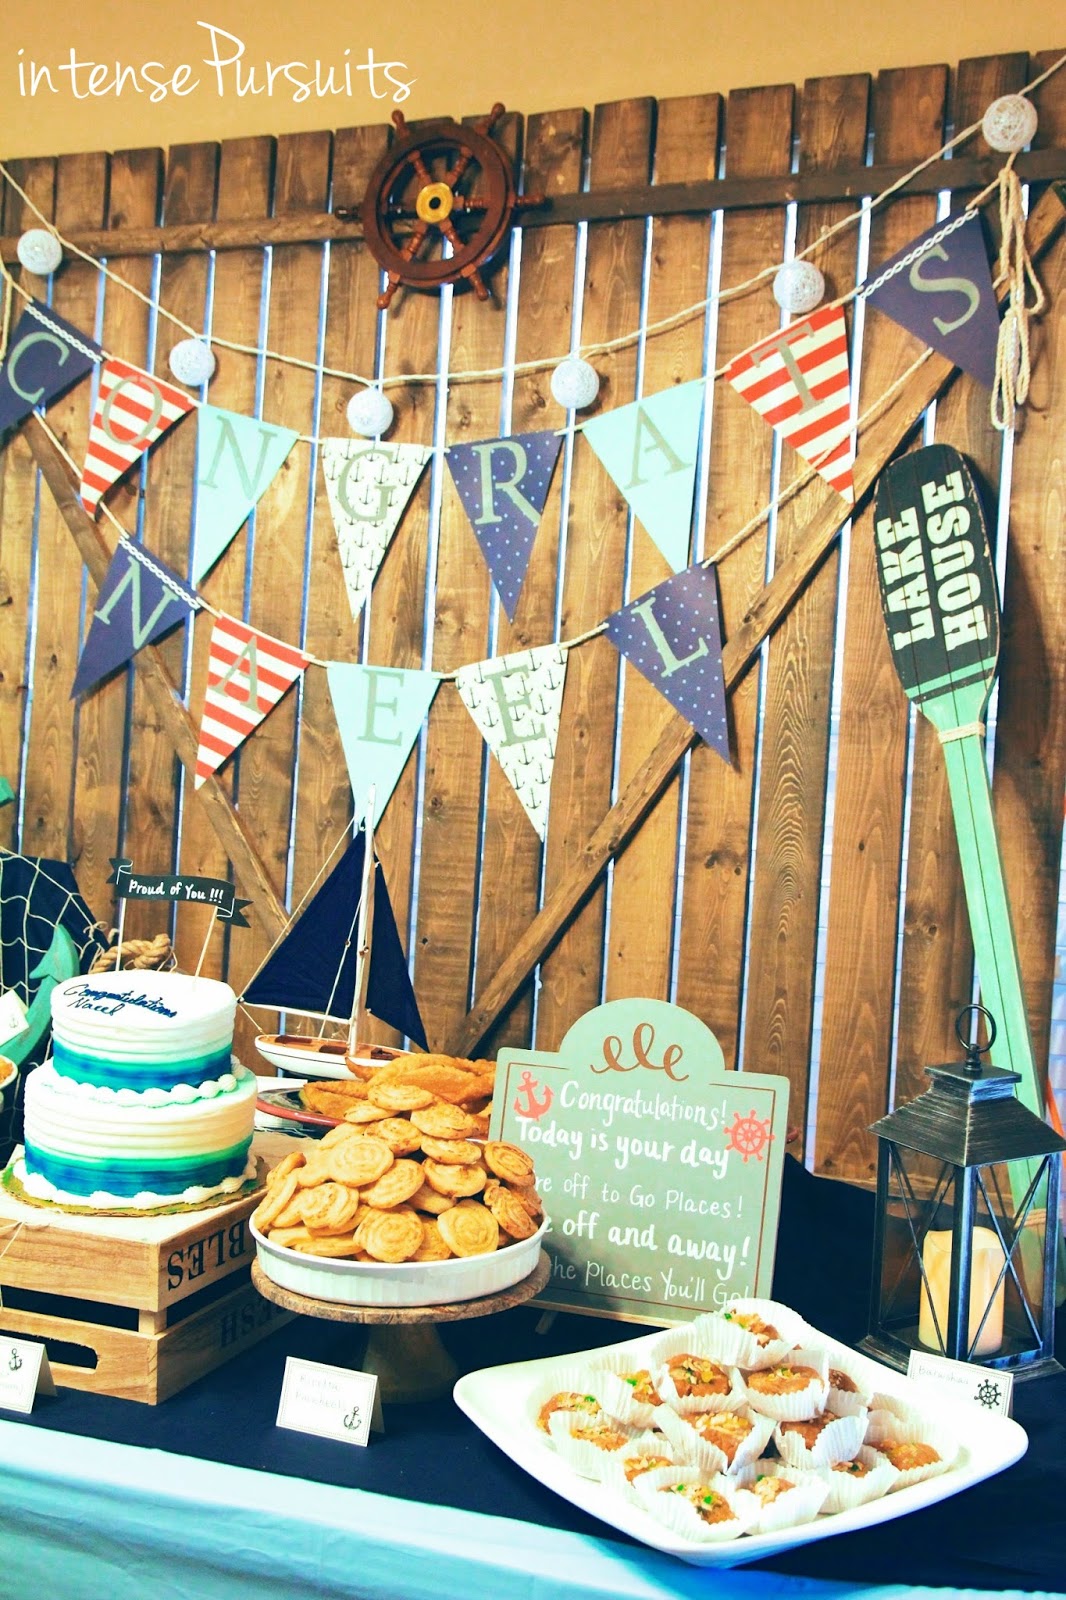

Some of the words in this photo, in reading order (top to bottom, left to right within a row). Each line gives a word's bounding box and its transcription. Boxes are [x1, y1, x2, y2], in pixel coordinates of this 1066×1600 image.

[877, 507, 935, 650] LAKE
[921, 470, 988, 651] HOUSE
[128, 879, 165, 896] Proud
[170, 882, 181, 895] of
[185, 884, 206, 900] You
[559, 1080, 727, 1131] Congratulations!
[515, 1116, 583, 1160] Today
[590, 1128, 608, 1149] is
[616, 1139, 675, 1169] your
[680, 1140, 729, 1180] day
[534, 1175, 553, 1192] re
[563, 1172, 590, 1200] off
[601, 1183, 620, 1203] to
[629, 1184, 655, 1208] Go
[665, 1189, 743, 1219] Places!
[167, 1217, 252, 1292] BLES
[562, 1209, 600, 1239] off
[607, 1223, 658, 1251] and
[667, 1233, 751, 1281] away!
[550, 1255, 577, 1280] he
[585, 1259, 652, 1292] Places
[660, 1267, 706, 1302] You'll
